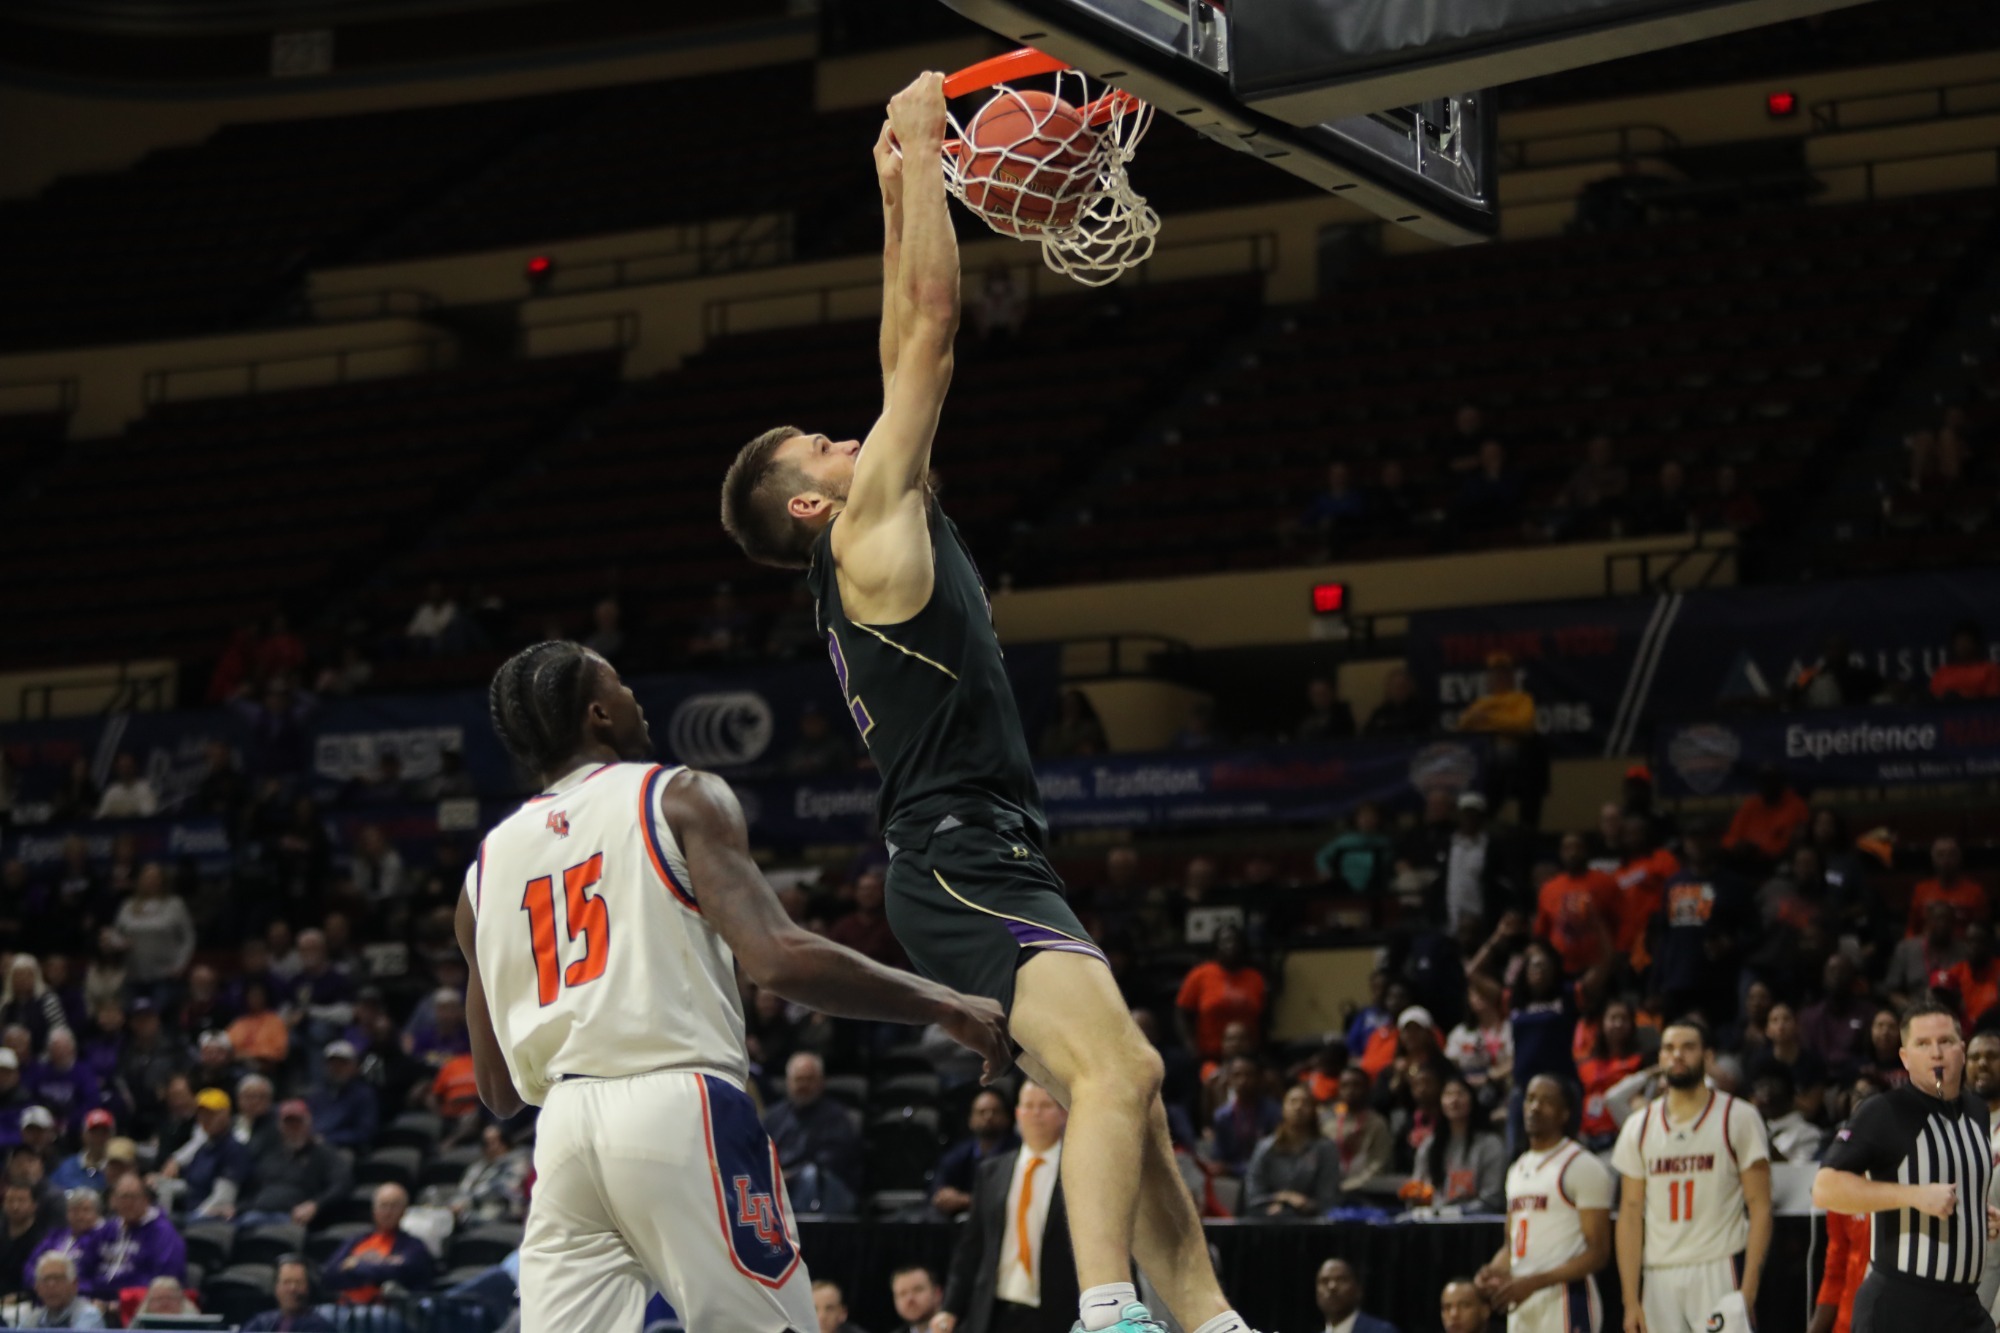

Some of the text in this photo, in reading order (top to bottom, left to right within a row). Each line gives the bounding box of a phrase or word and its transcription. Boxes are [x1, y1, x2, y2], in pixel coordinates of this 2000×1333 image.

[1786, 720, 1937, 763] Experience
[520, 850, 610, 1009] 15
[1649, 1154, 1715, 1175] LANGSTON
[1669, 1179, 1694, 1224] 11
